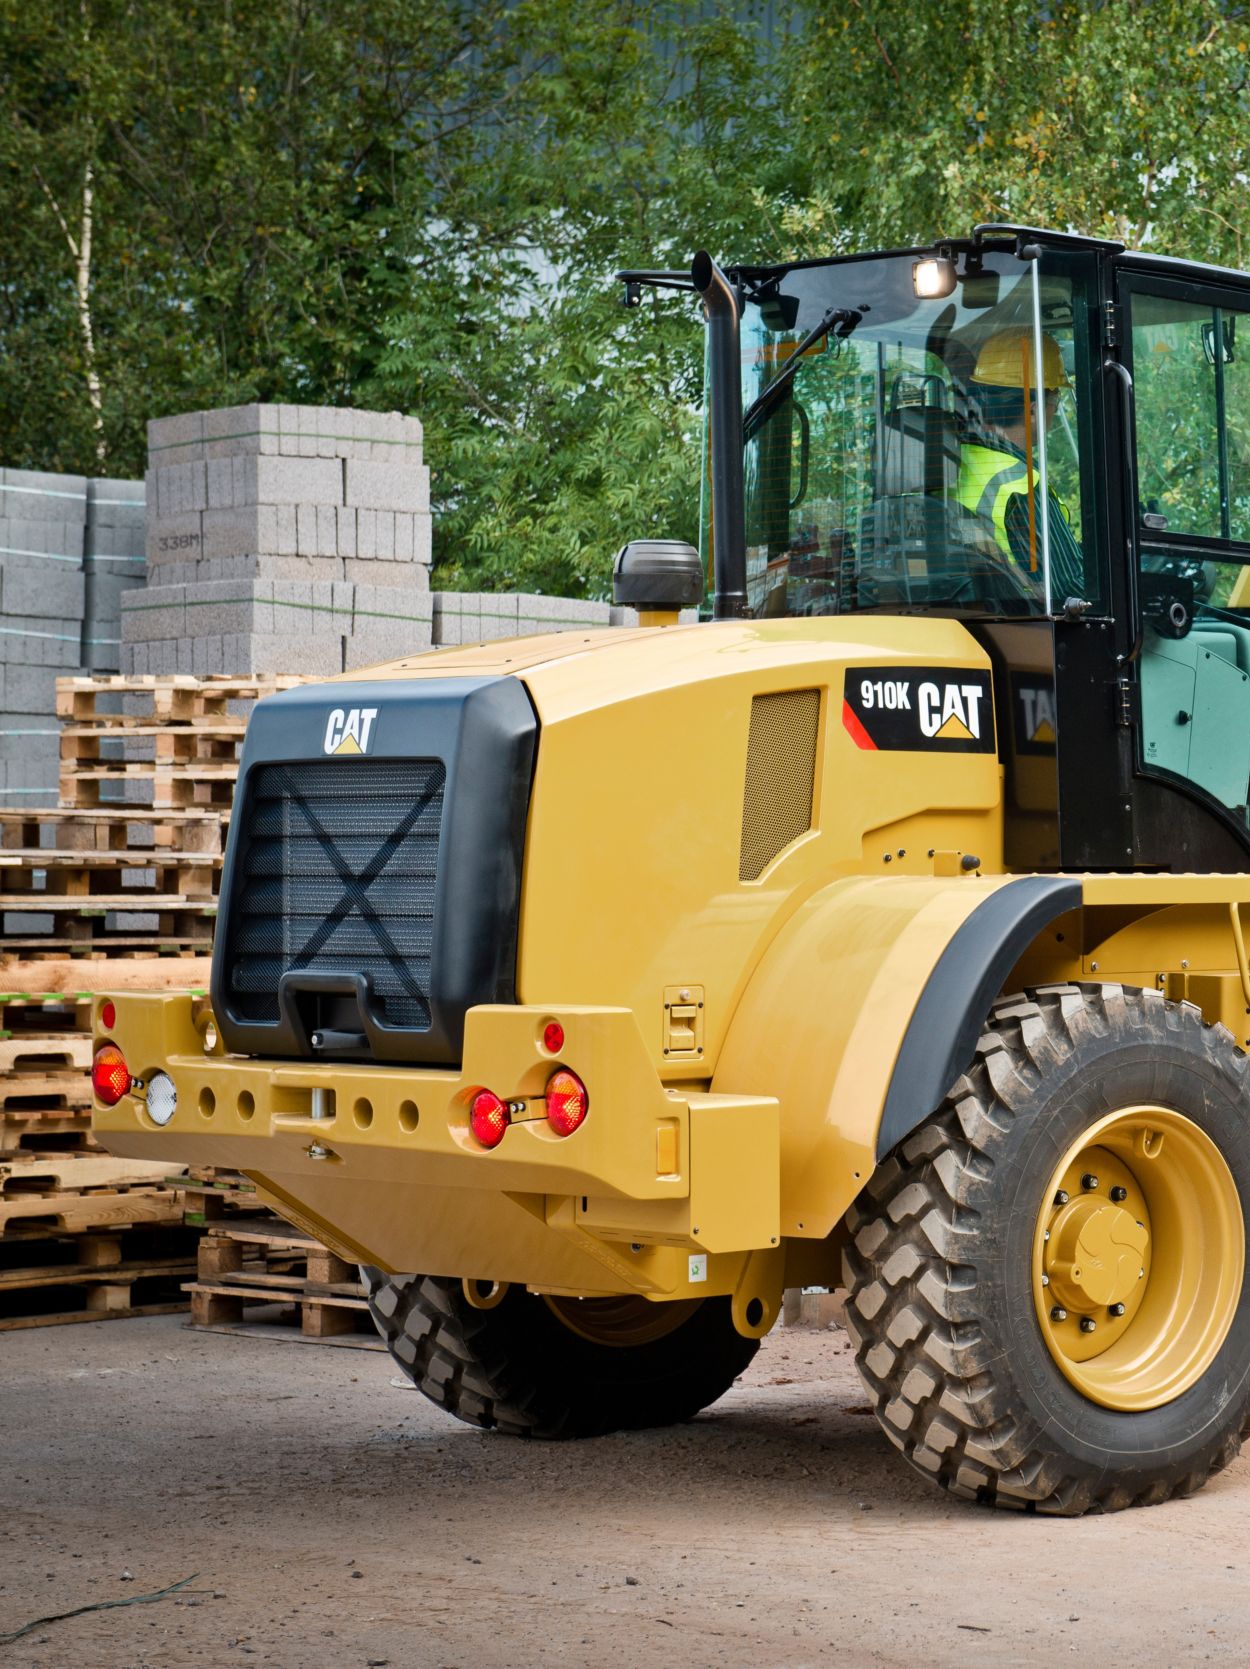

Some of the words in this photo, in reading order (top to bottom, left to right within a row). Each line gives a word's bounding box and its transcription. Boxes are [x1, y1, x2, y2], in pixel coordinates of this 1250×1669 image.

[323, 708, 378, 755] CAT
[860, 680, 911, 710] 910K
[917, 682, 983, 739] CAT
